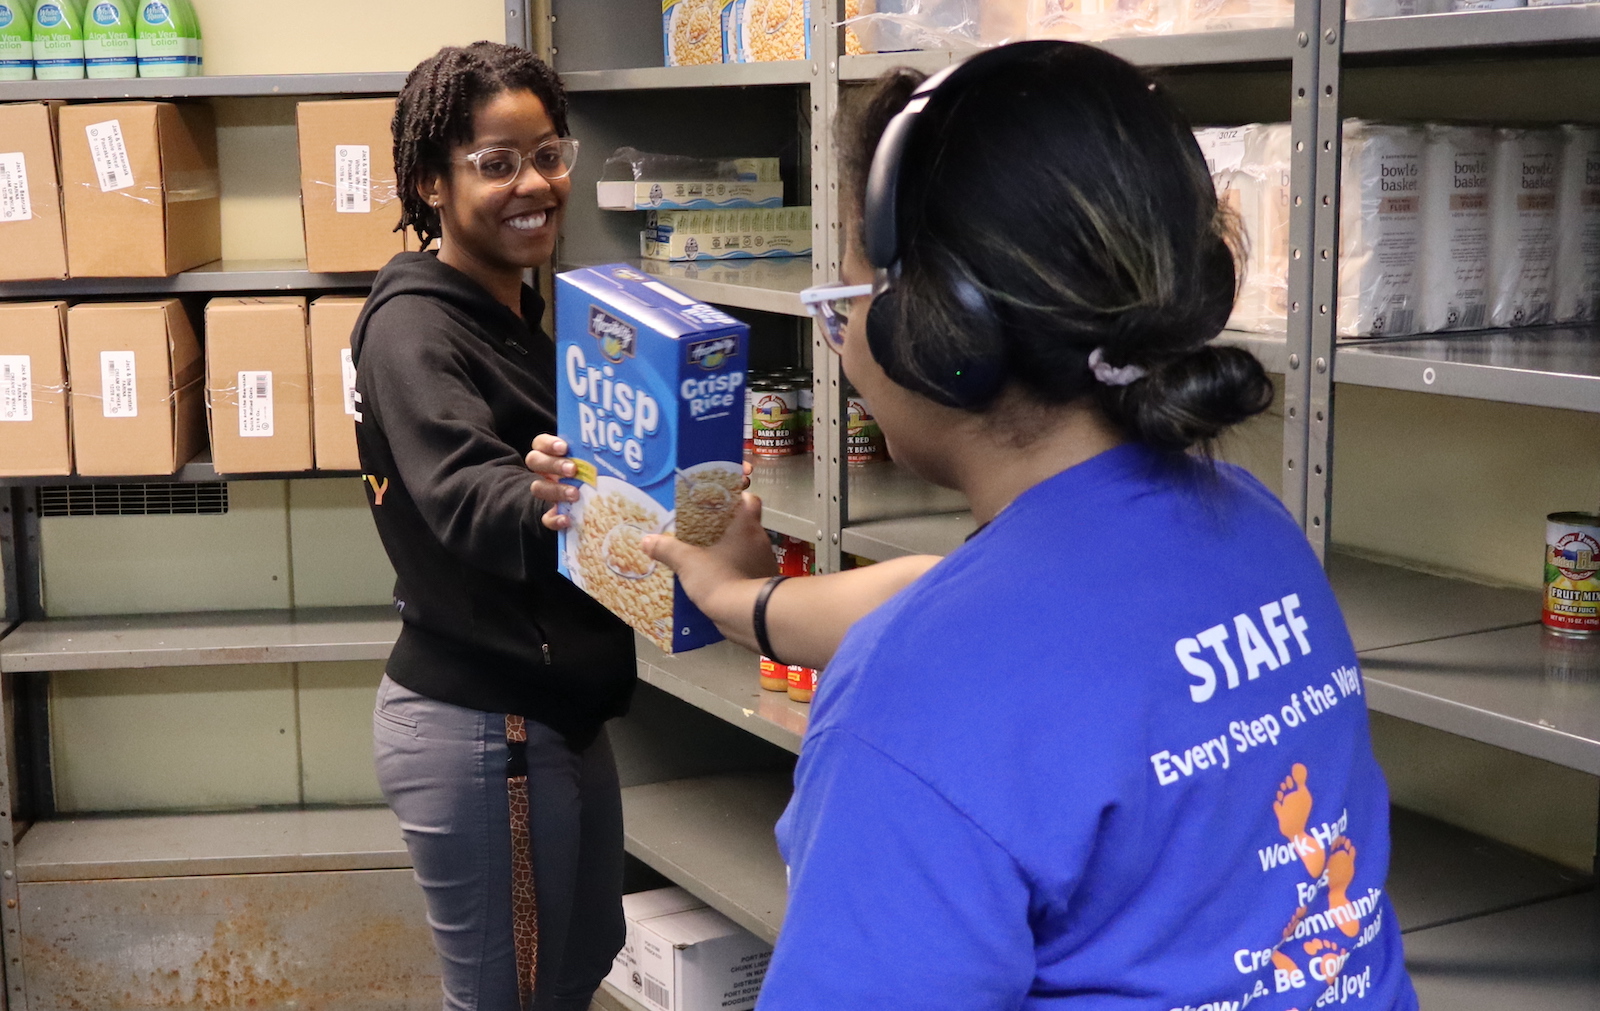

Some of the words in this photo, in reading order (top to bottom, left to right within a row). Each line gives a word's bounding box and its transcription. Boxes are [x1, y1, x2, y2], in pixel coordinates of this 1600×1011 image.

[34, 34, 50, 42] Aloe
[52, 33, 71, 41] Vera
[89, 32, 106, 40] Aloe
[108, 31, 128, 39] Vera
[140, 31, 157, 40] Aloe
[44, 41, 72, 49] Lotion
[151, 38, 178, 46] Lotion
[1381, 178, 1418, 192] basket
[566, 344, 659, 439] Crisp
[680, 371, 744, 400] Crisp
[690, 394, 735, 417] Rice
[579, 402, 644, 470] Rice
[776, 429, 790, 437] RED
[855, 436, 870, 444] RED
[1551, 587, 1581, 601] FRUIT
[1560, 603, 1578, 613] PEAR
[1578, 605, 1597, 614] JUICE
[1175, 593, 1311, 703] STAFF
[1150, 735, 1230, 786] Every
[1229, 714, 1280, 753] Step
[1281, 693, 1307, 728] of
[1302, 685, 1338, 716] the
[1331, 665, 1362, 698] Way
[1258, 835, 1316, 872] Work
[1310, 808, 1348, 850] Hard
[741, 954, 759, 963] PORT
[730, 964, 753, 973] CHUNK
[1274, 968, 1307, 993] Be
[1340, 965, 1372, 1004] Joy!
[723, 989, 741, 999] PORT
